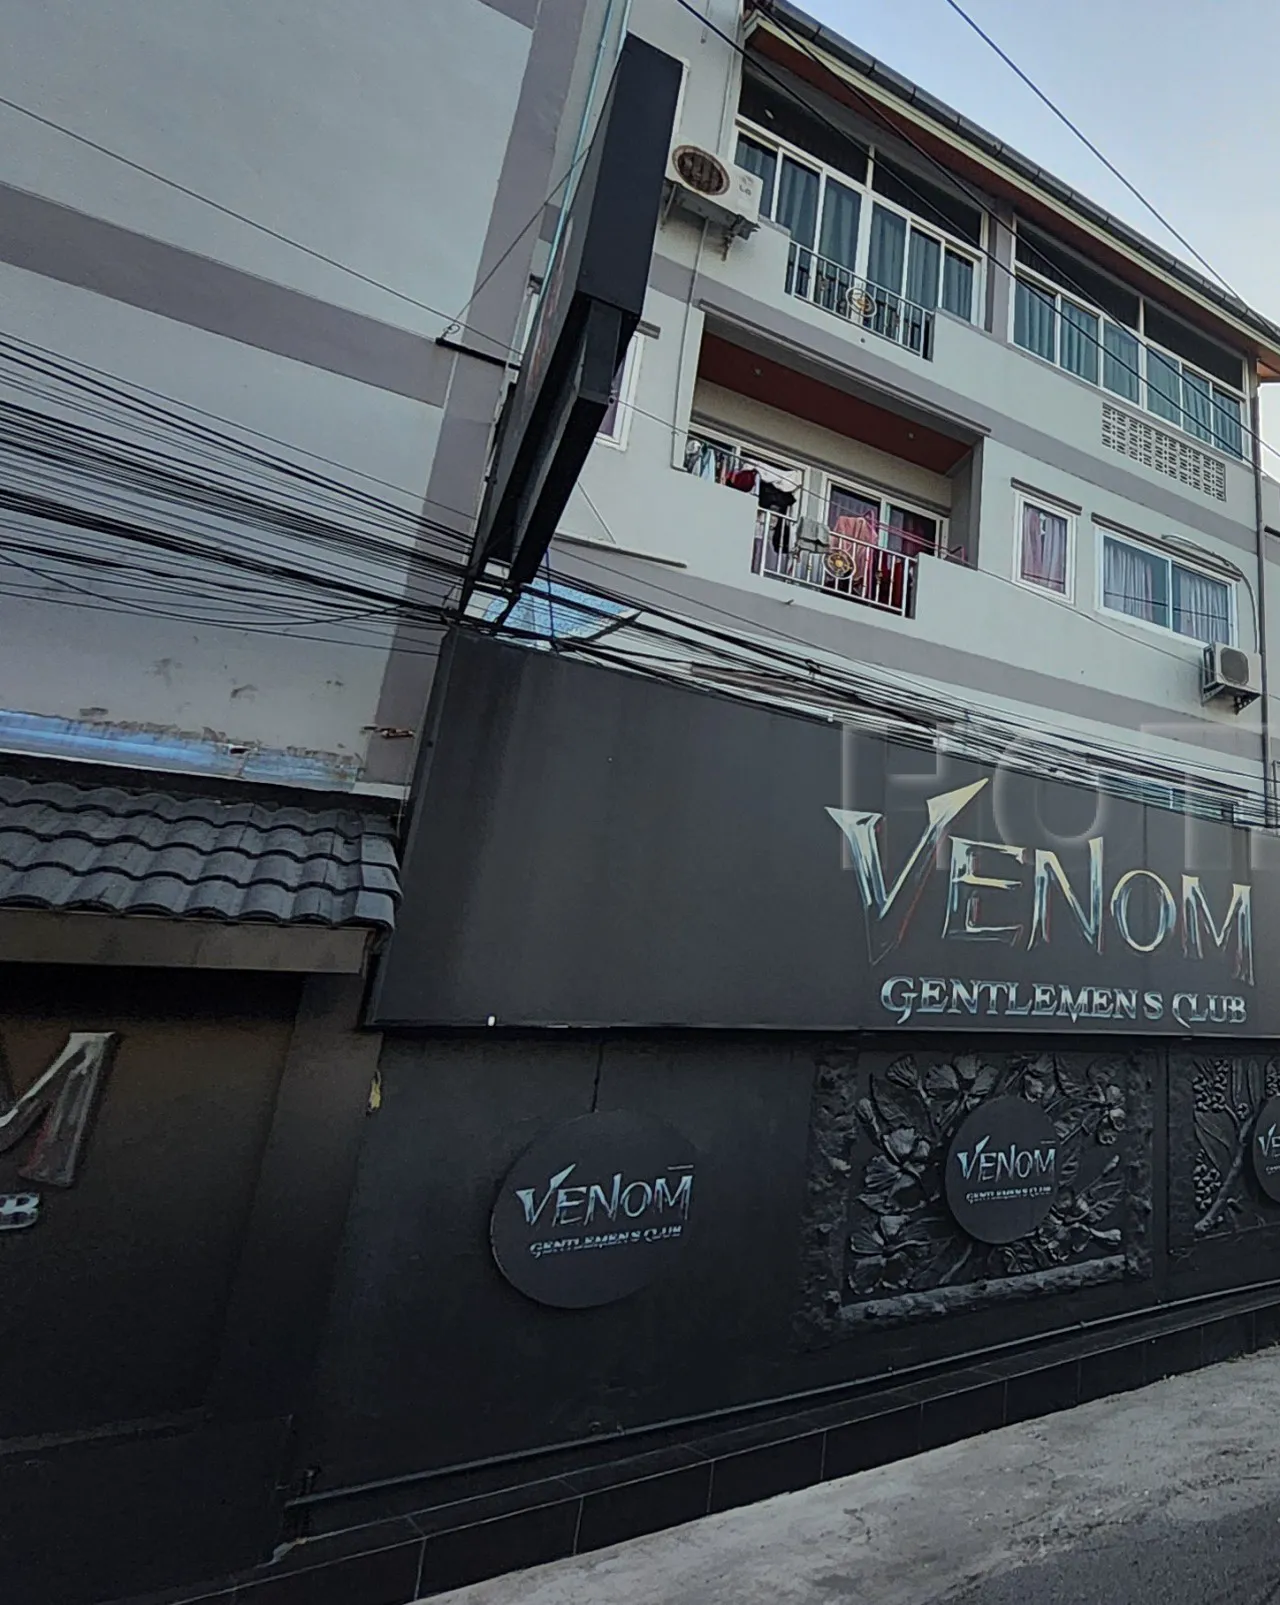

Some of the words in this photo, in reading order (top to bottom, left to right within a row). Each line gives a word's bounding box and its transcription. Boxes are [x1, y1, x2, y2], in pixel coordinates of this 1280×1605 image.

[824, 778, 1255, 985] VENOM
[1171, 991, 1248, 1029] CLUB
[956, 1135, 1057, 1183] VENOM
[515, 1163, 694, 1227] VENOM
